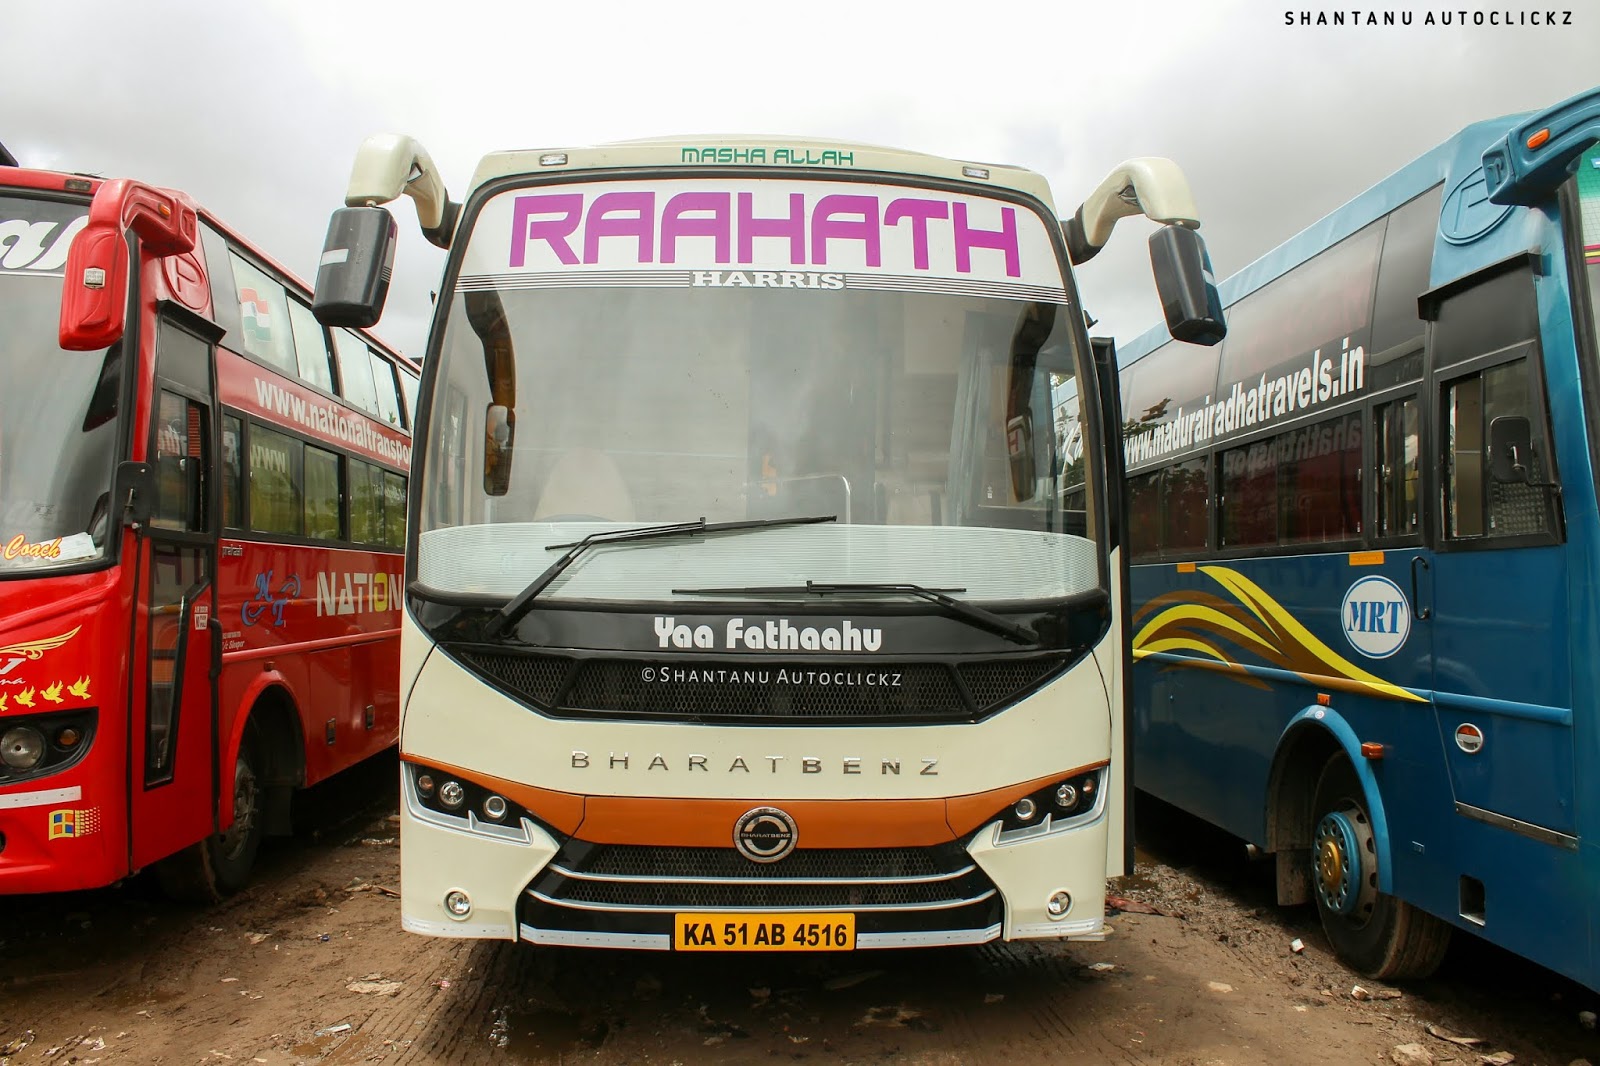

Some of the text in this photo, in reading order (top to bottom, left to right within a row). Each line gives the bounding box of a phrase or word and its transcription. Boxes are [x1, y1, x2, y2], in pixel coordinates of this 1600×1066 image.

[682, 148, 854, 166] MASHA ALLAH
[509, 191, 1021, 278] RAAHATH
[692, 271, 845, 290] HARRIS
[4, 533, 63, 560] Coach
[316, 571, 402, 617] NATION
[1347, 600, 1404, 634] MRT
[654, 616, 882, 651] Yaa Fathaahu
[571, 751, 939, 777] BHARATBENZ
[684, 923, 847, 947] KA 51 AB 4516
